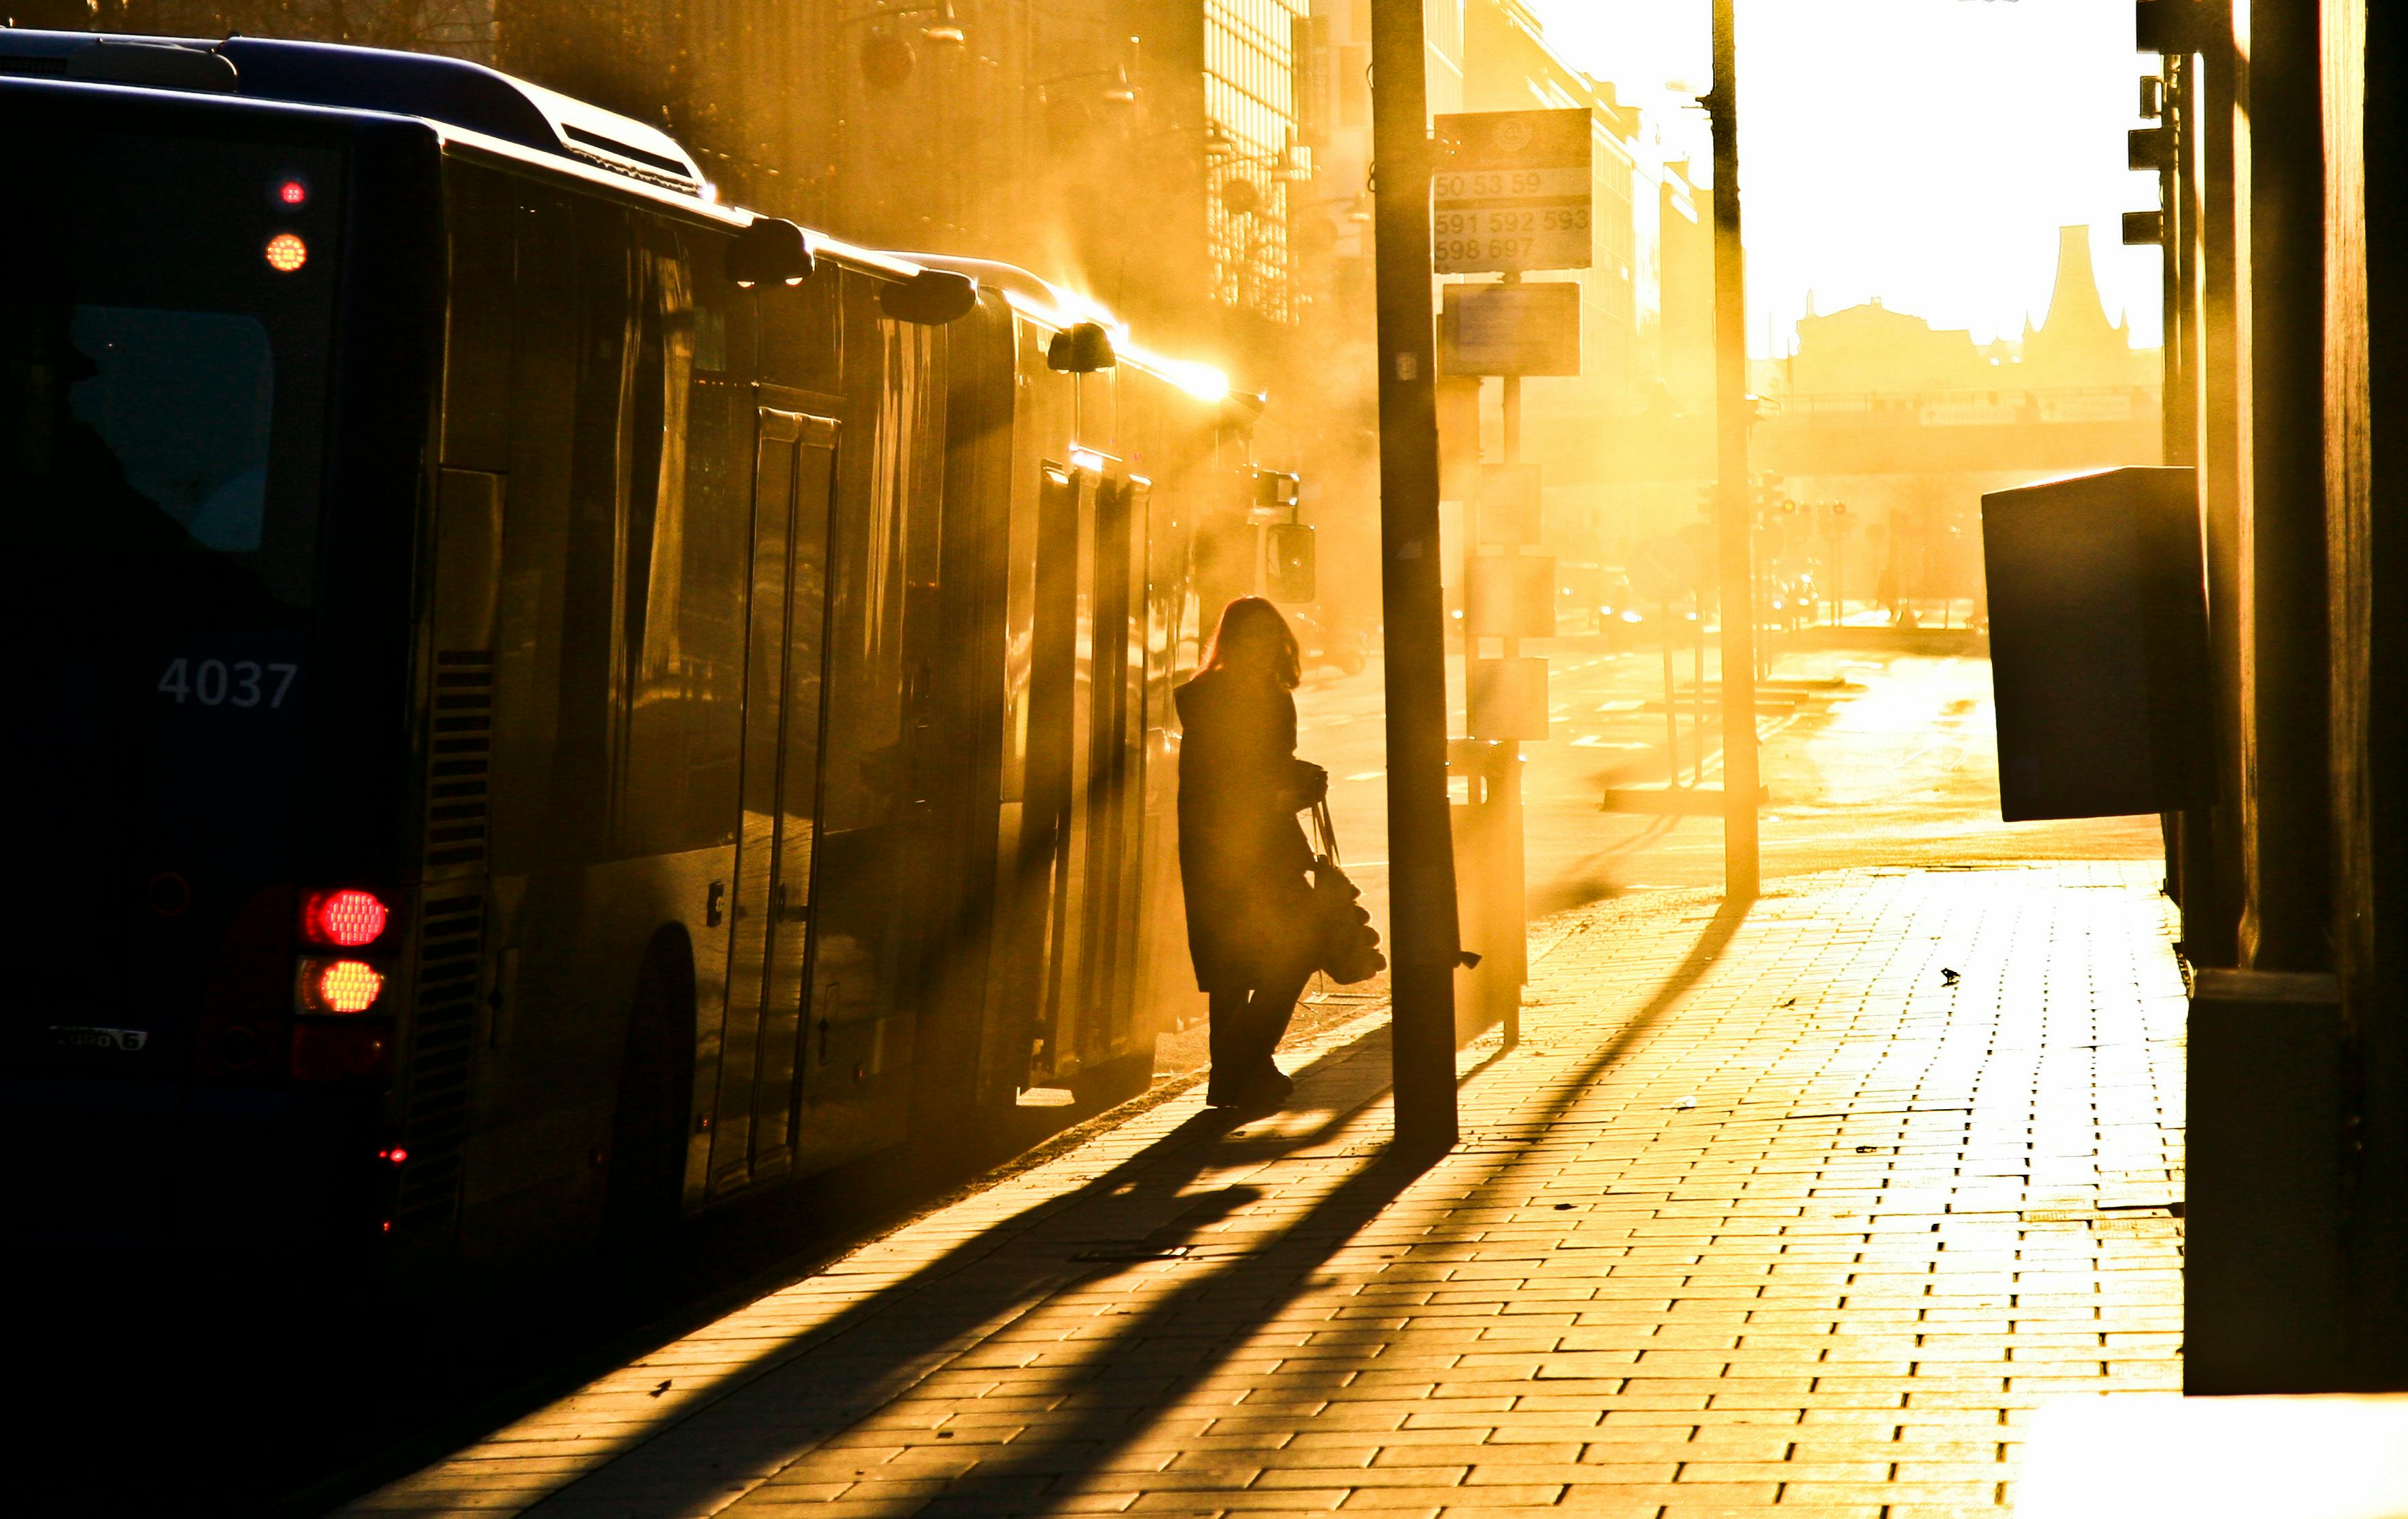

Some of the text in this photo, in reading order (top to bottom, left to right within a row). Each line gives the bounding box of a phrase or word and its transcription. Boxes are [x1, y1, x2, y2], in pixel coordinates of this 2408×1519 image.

[1435, 173, 1541, 195] 50 53 59
[1435, 209, 1589, 234] 591 592 593
[1435, 238, 1534, 261] 598 697
[157, 658, 299, 709] 4037
